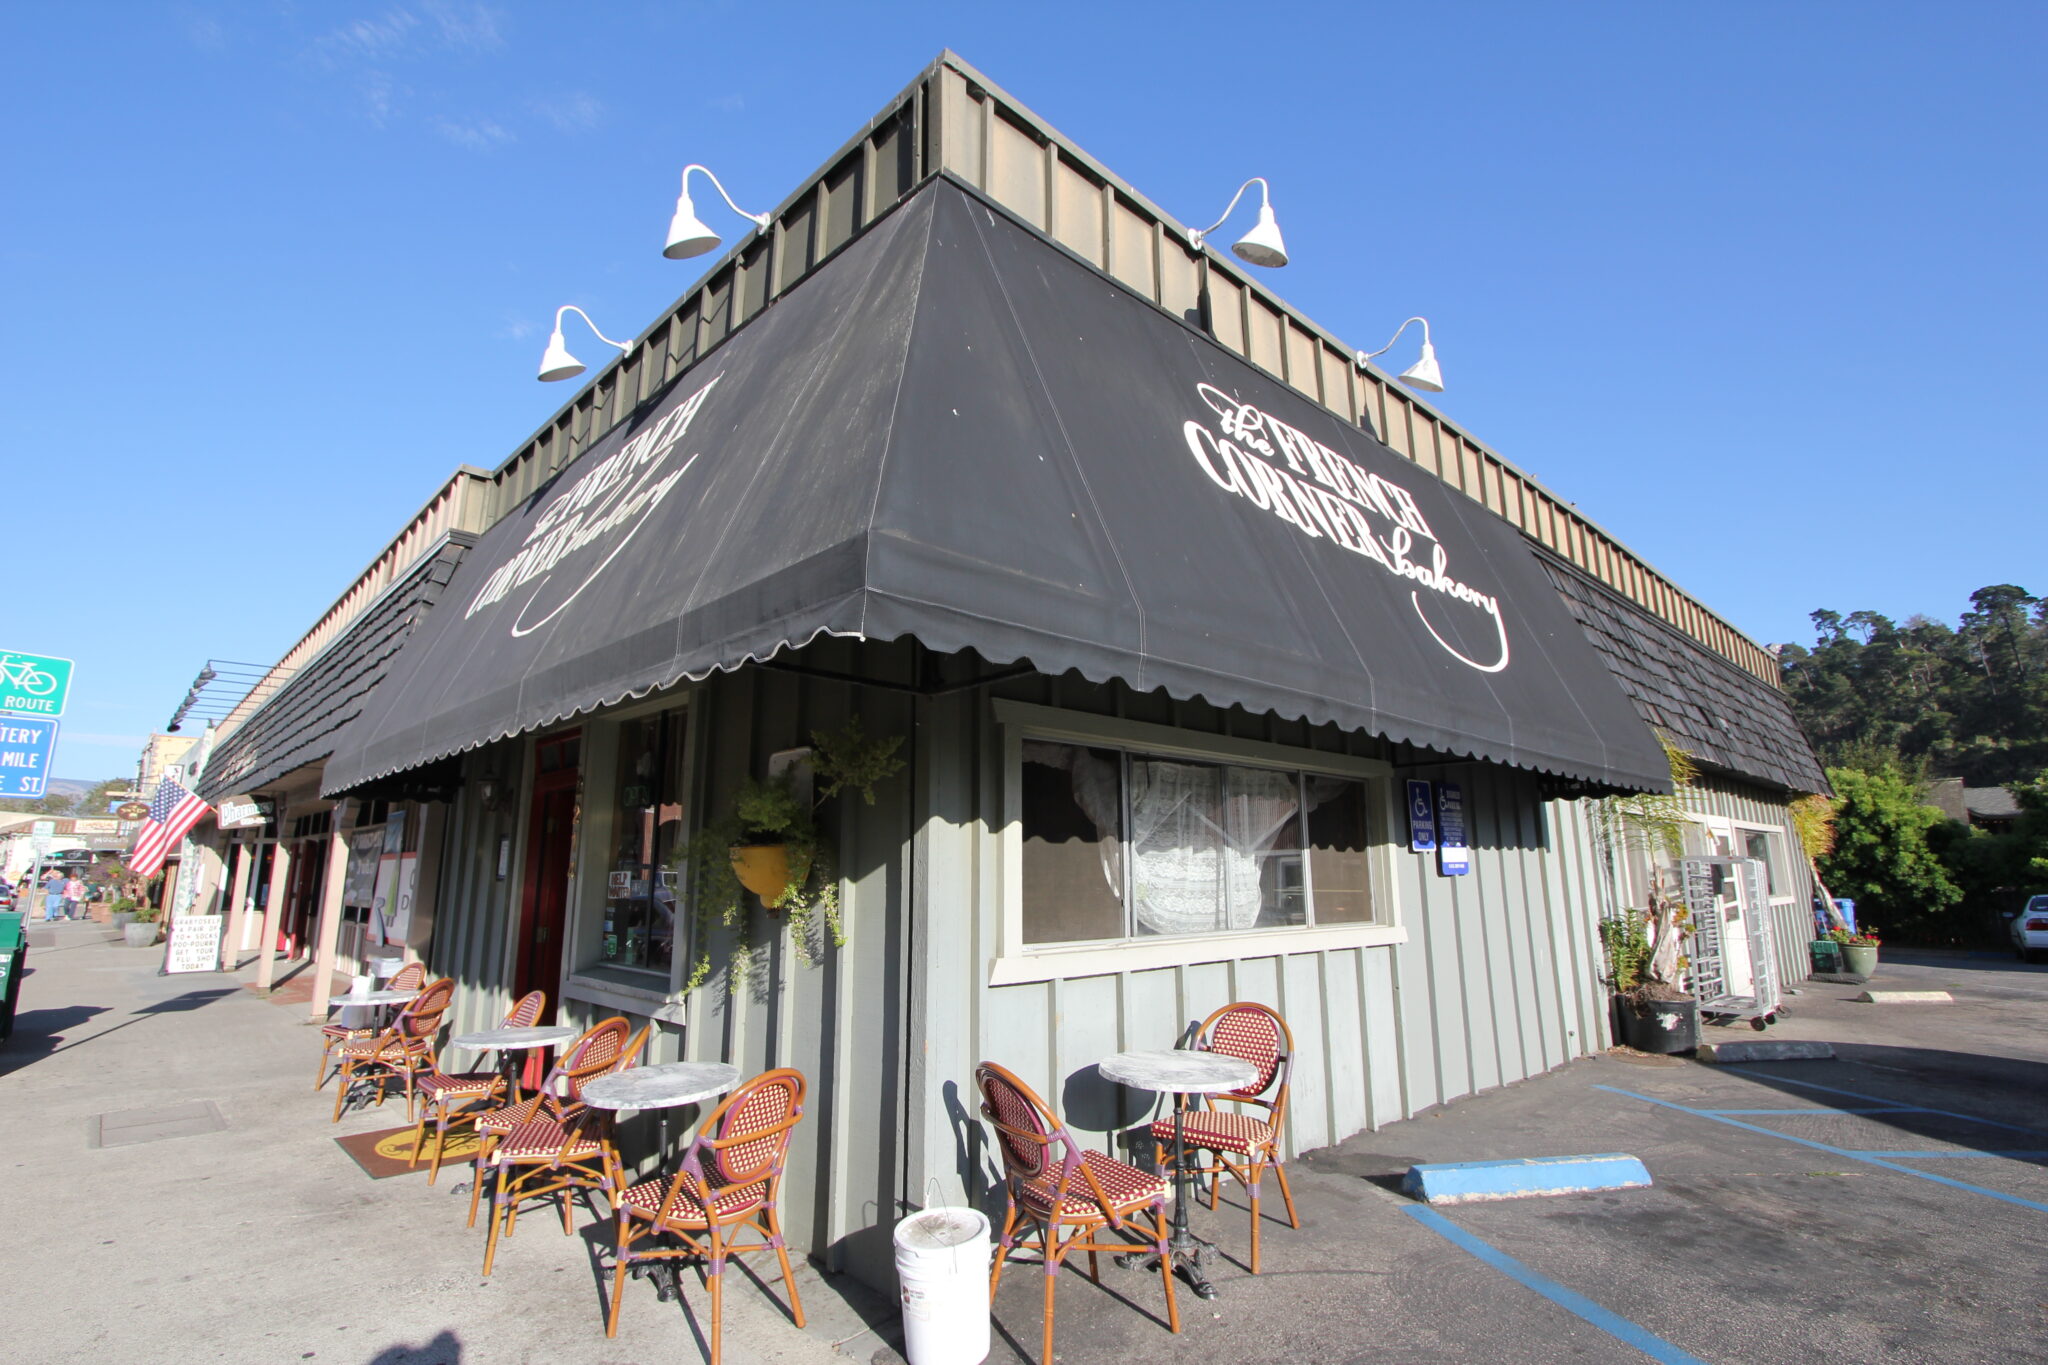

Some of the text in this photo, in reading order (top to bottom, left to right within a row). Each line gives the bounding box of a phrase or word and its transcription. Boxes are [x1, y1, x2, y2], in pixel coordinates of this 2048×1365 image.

[555, 369, 725, 525] FRENCH
[1197, 382, 1438, 542] the FRENCH
[1184, 420, 1508, 672] CORNER bakery
[465, 511, 584, 620] CORNER
[4, 695, 55, 712] ROUTE
[2, 751, 40, 769] MILE
[19, 776, 41, 793] ST.
[1412, 820, 1433, 830] PARKING
[611, 872, 628, 886] HELP
[175, 948, 189, 956] GET
